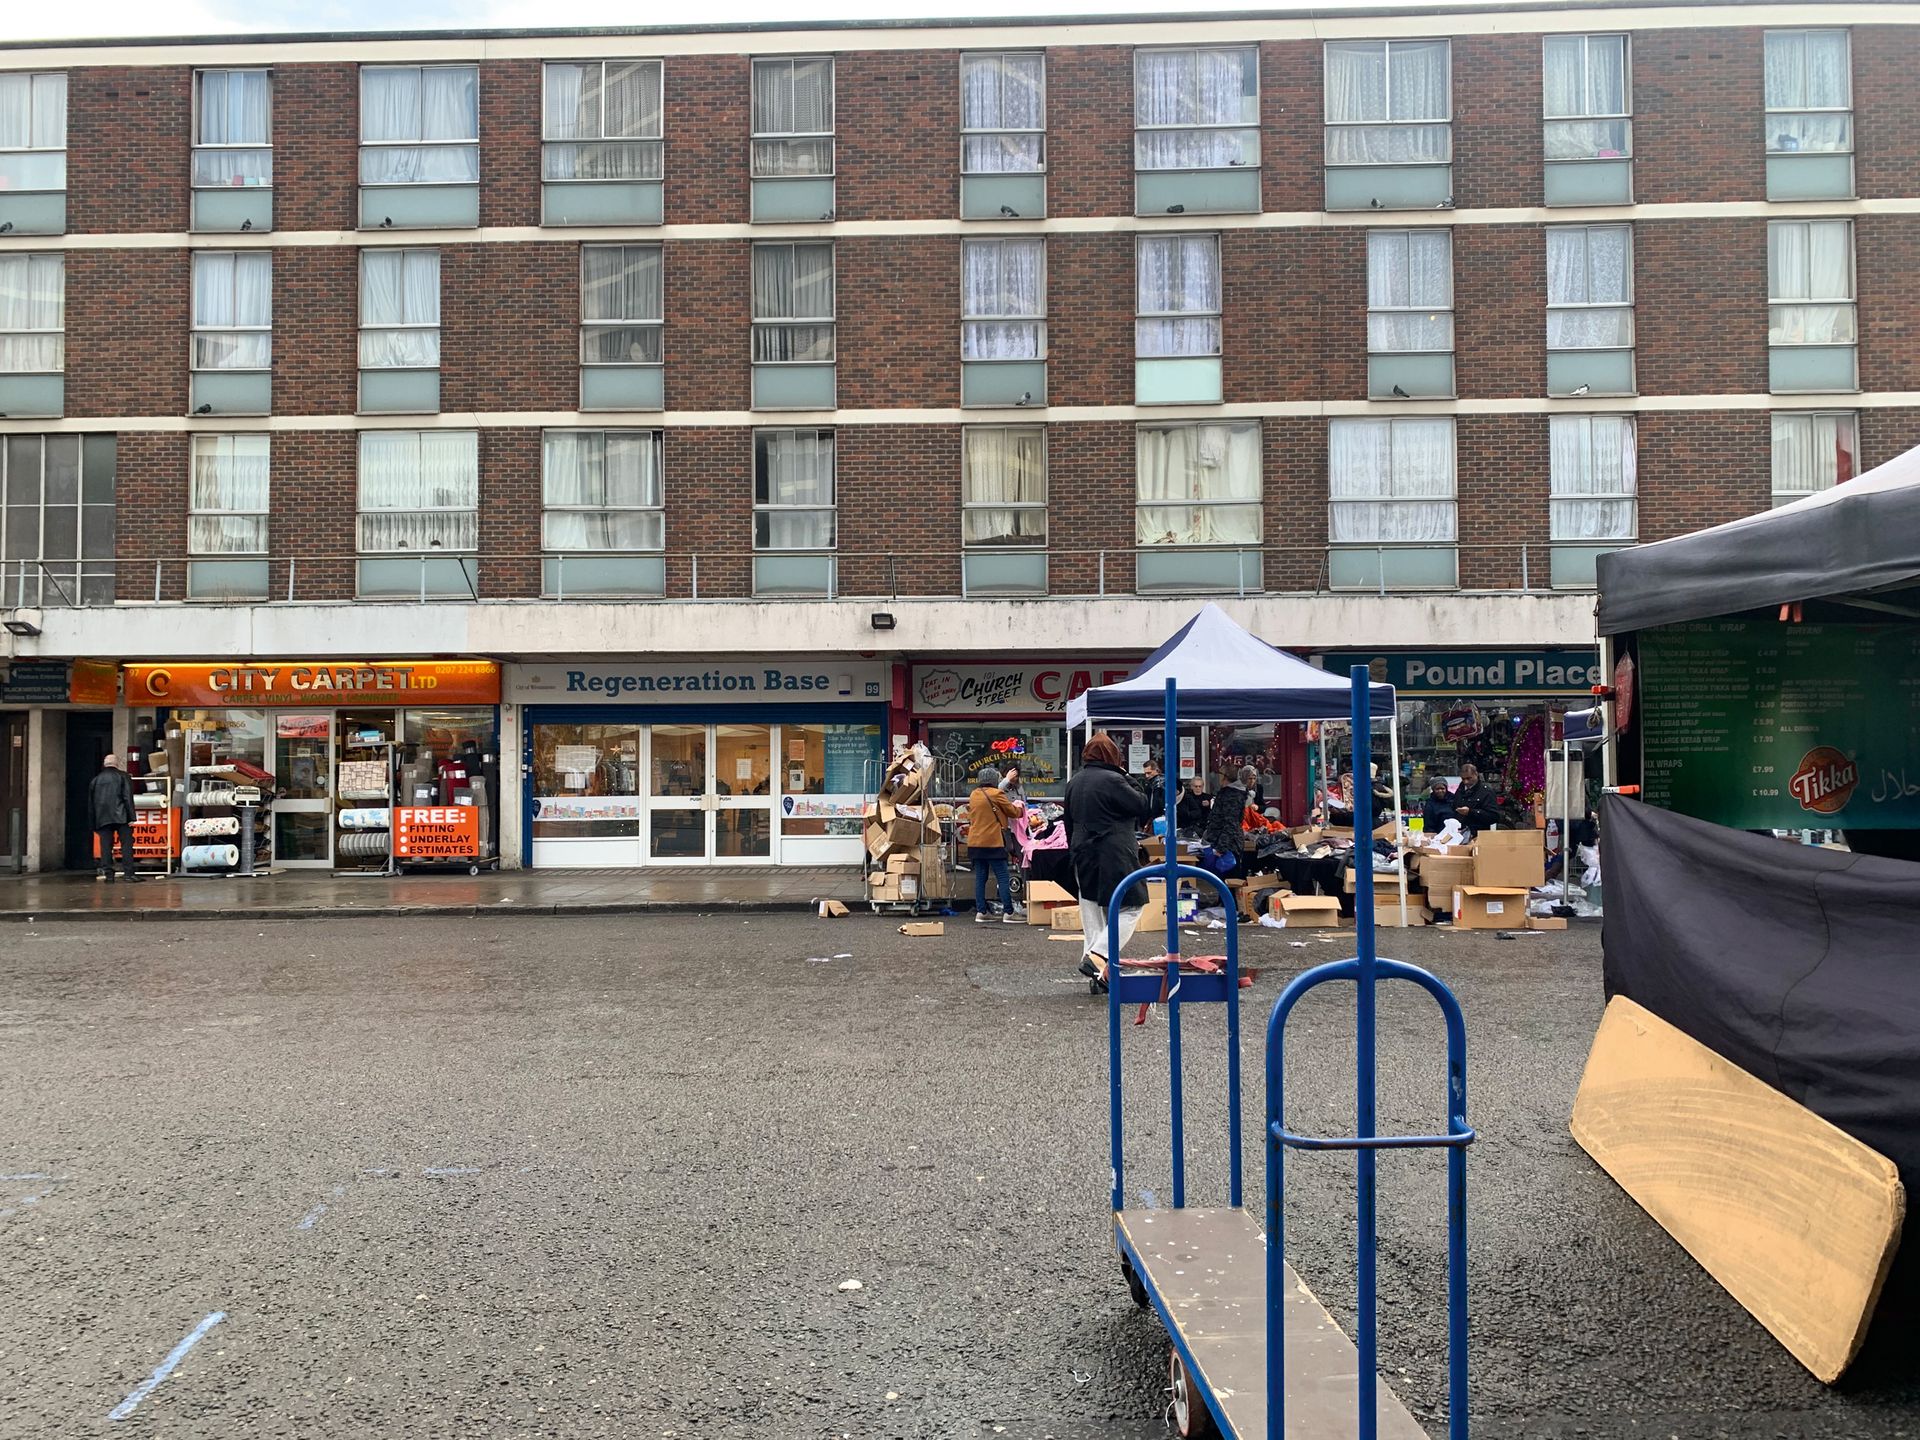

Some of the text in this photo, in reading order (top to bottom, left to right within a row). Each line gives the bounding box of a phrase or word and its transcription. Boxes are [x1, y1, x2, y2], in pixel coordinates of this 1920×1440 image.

[209, 667, 437, 691] CITY CARPET LTD
[1406, 660, 1601, 685] Pound Place
[567, 670, 829, 697] Regeneration Base
[867, 685, 879, 694] 99
[961, 672, 1023, 699] CHURCH
[976, 686, 1022, 706] STREET
[968, 754, 1000, 772] CHURCH
[1219, 755, 1275, 768] MERRY
[1656, 759, 1684, 768] WRAPS
[1793, 764, 1854, 803] Tikka
[136, 811, 168, 824] EE:
[400, 809, 466, 824] FREE:
[132, 825, 157, 834] TING
[410, 835, 471, 843] UNDERLAY
[410, 846, 473, 854] ESTIMATES
